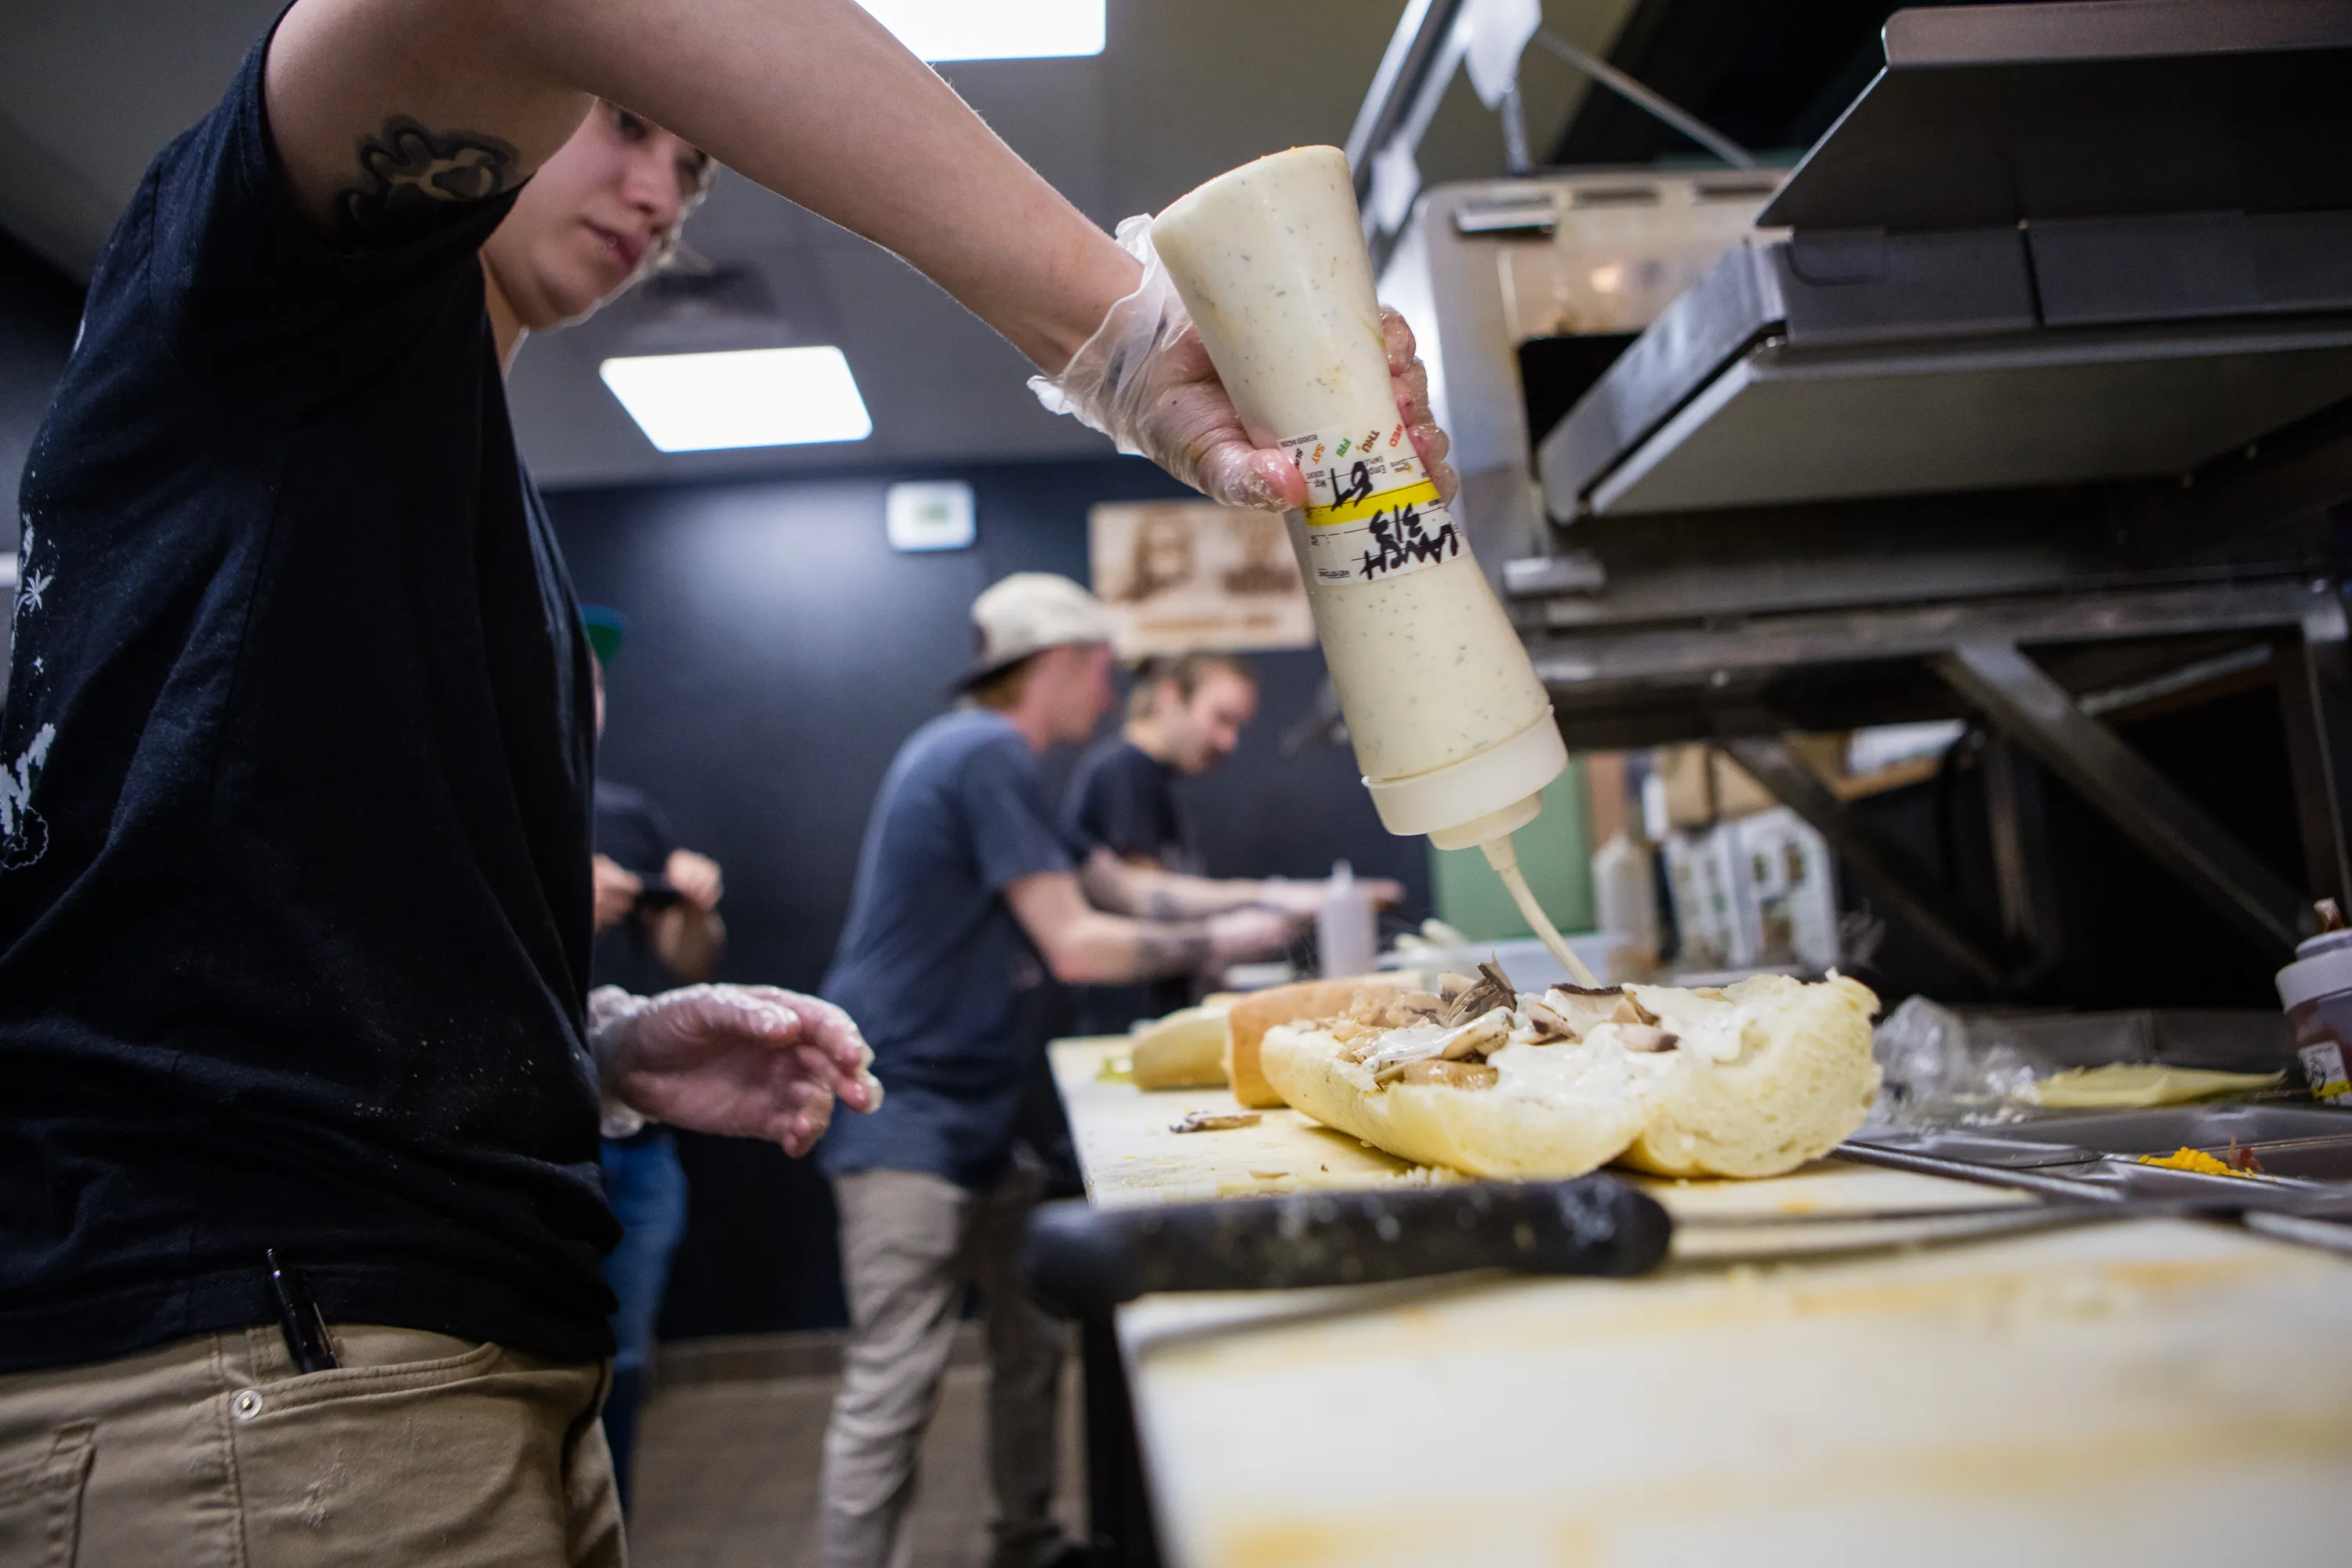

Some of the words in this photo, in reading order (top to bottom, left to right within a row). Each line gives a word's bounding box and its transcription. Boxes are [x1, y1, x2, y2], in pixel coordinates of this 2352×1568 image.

[1335, 437, 1352, 458] FRI
[1361, 430, 1380, 453] THU
[1311, 443, 1325, 465] SAT
